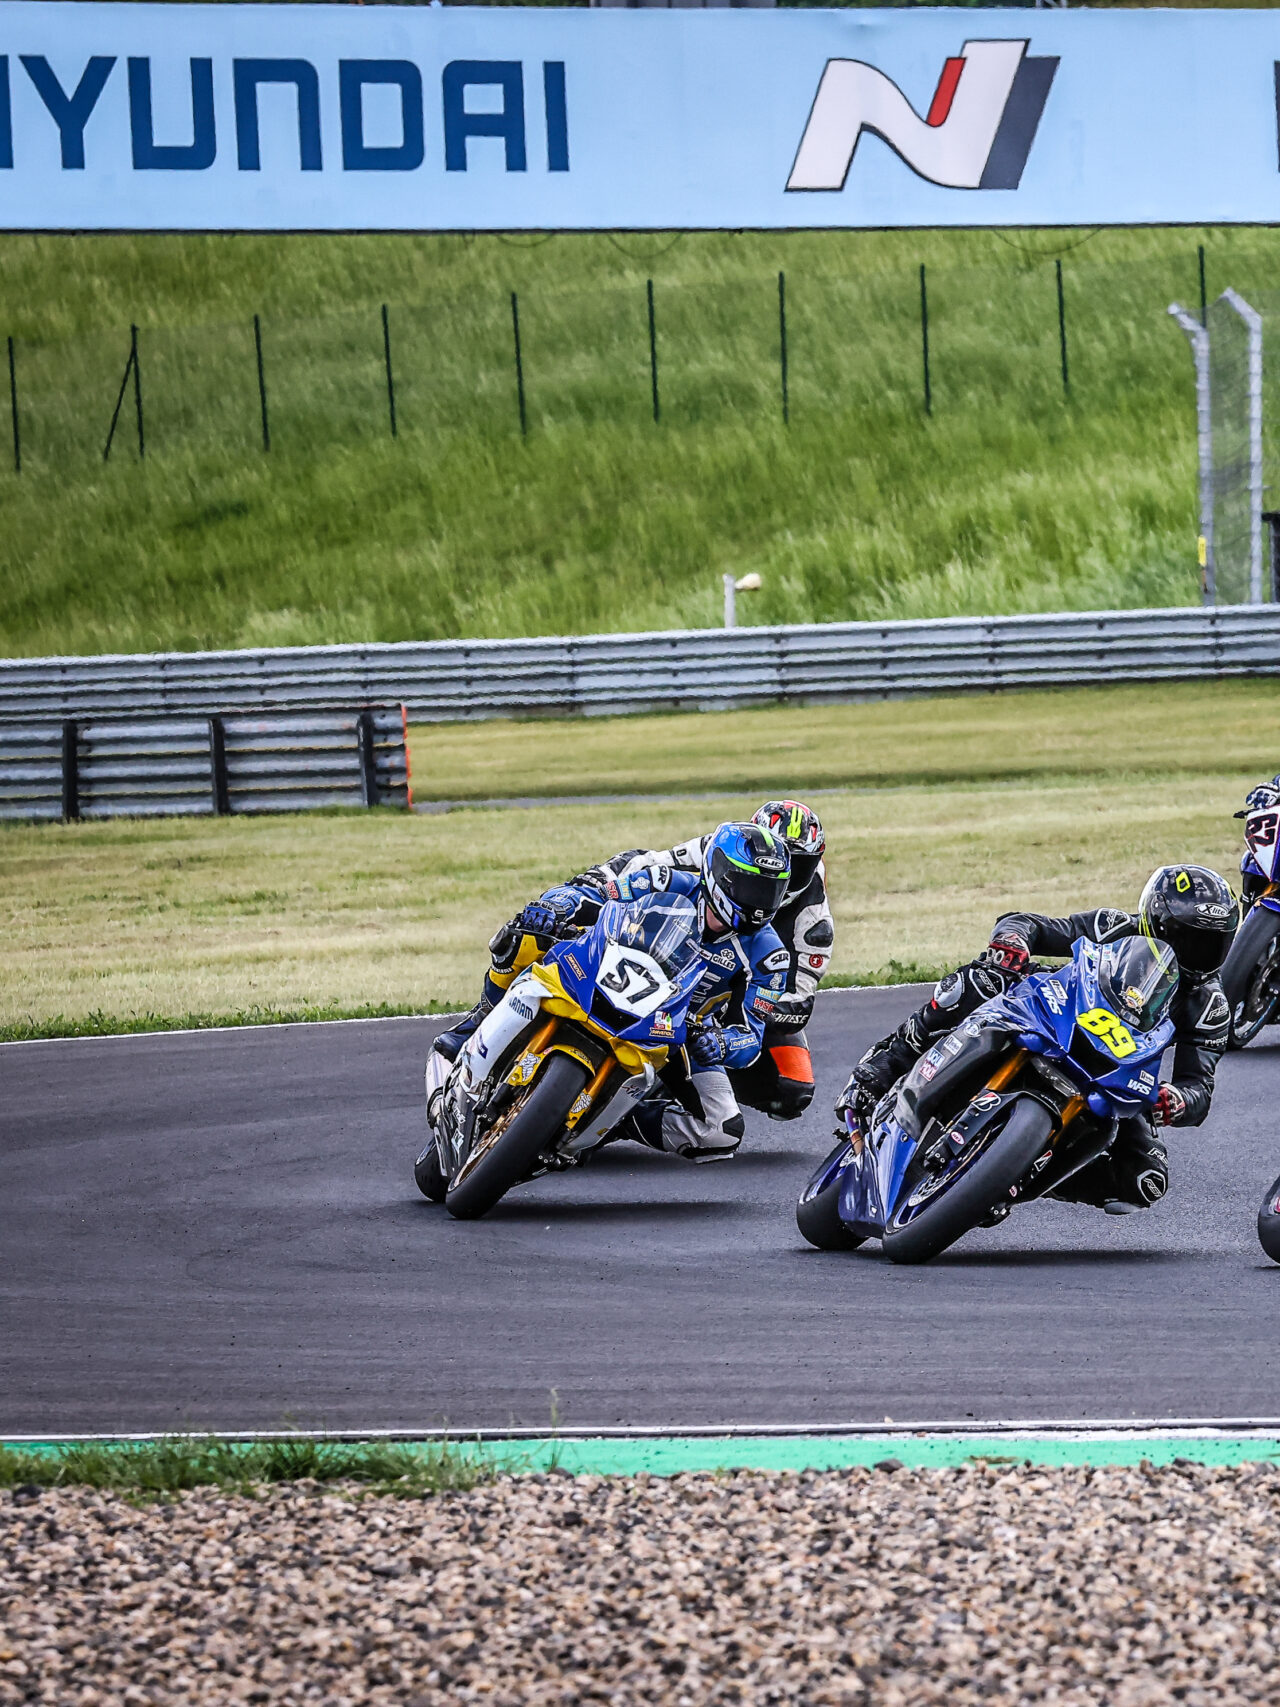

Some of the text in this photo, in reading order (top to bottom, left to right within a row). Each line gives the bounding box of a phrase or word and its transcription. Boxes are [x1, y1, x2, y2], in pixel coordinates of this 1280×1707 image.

[760, 858, 783, 868] HJC
[1202, 905, 1226, 917] X-lite
[712, 955, 735, 970] GILLES
[1040, 985, 1063, 1016] WRS
[1076, 1008, 1137, 1059] 89
[1127, 1079, 1152, 1096] WRS
